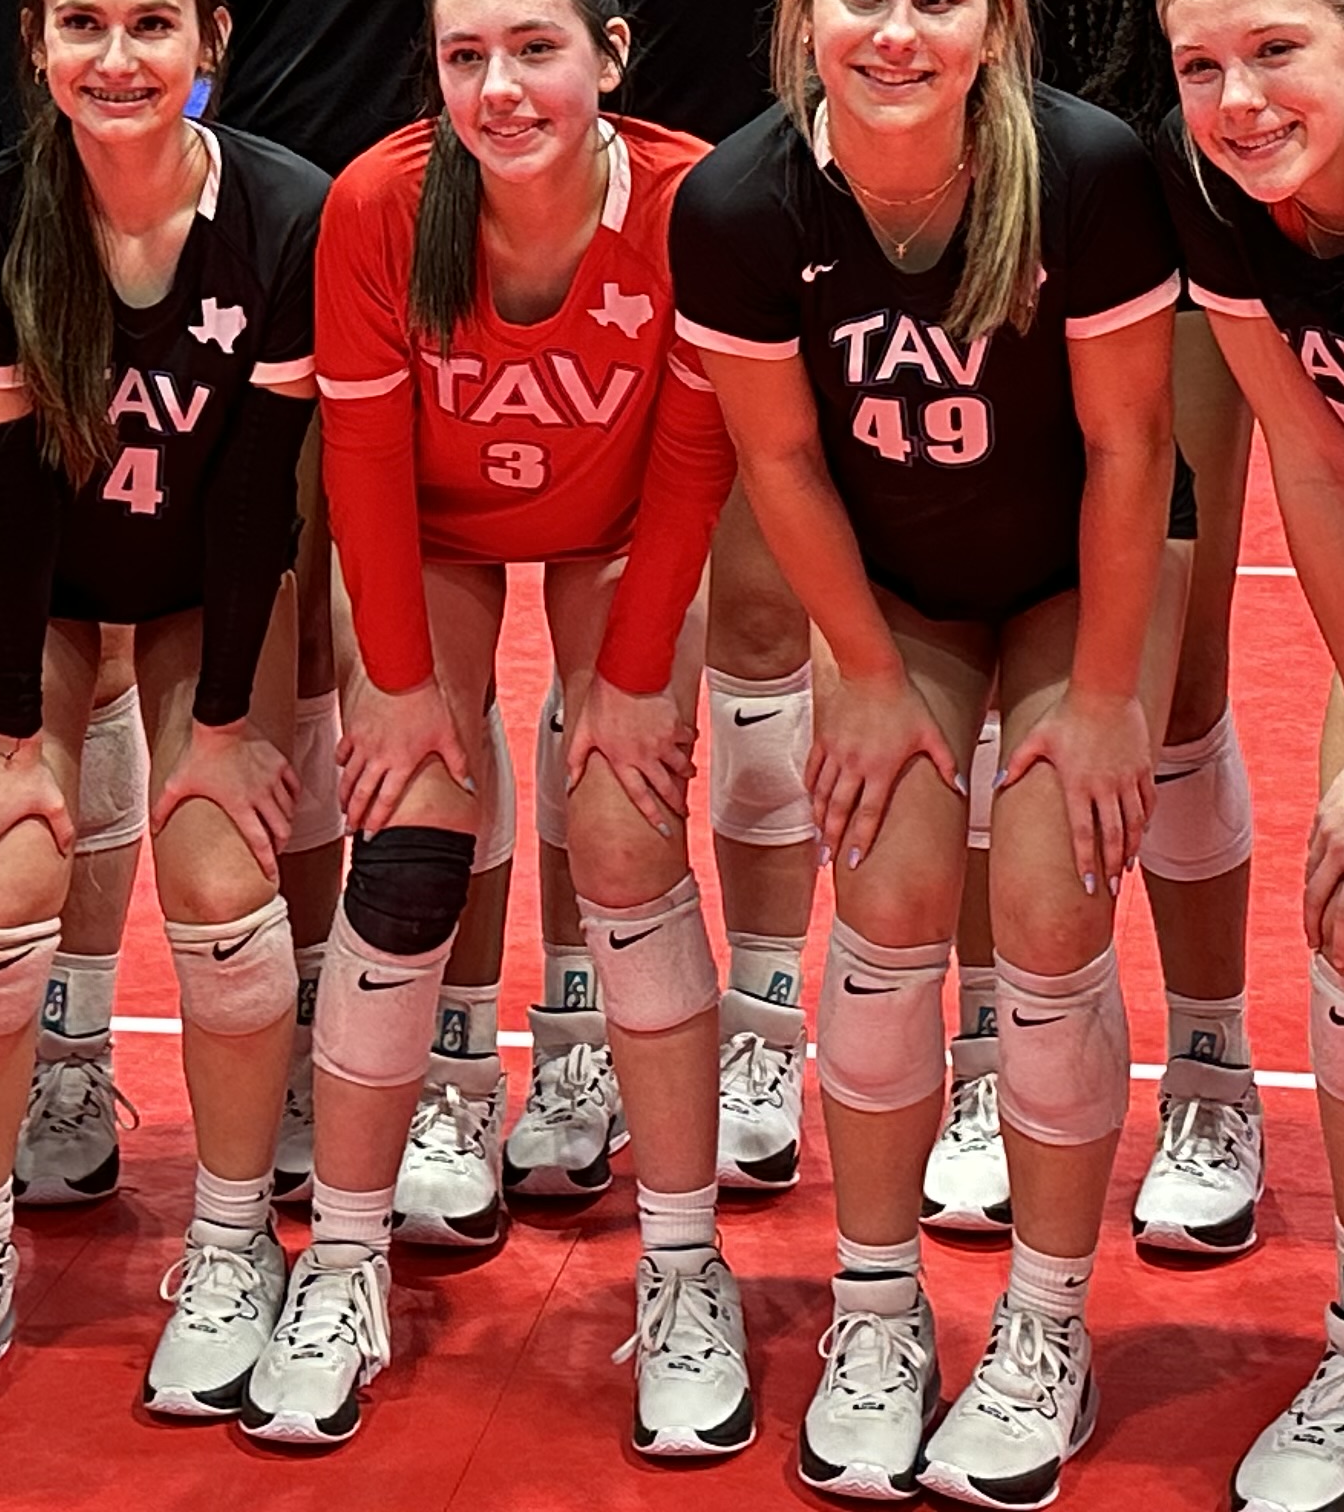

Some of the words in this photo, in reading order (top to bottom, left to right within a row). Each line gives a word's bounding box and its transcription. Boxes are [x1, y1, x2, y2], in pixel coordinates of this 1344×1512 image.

[831, 311, 992, 389] TAV
[106, 368, 211, 435] AV
[418, 351, 644, 431] TAV
[481, 439, 549, 490] 3
[852, 394, 996, 466] 49
[101, 445, 166, 516] 4
